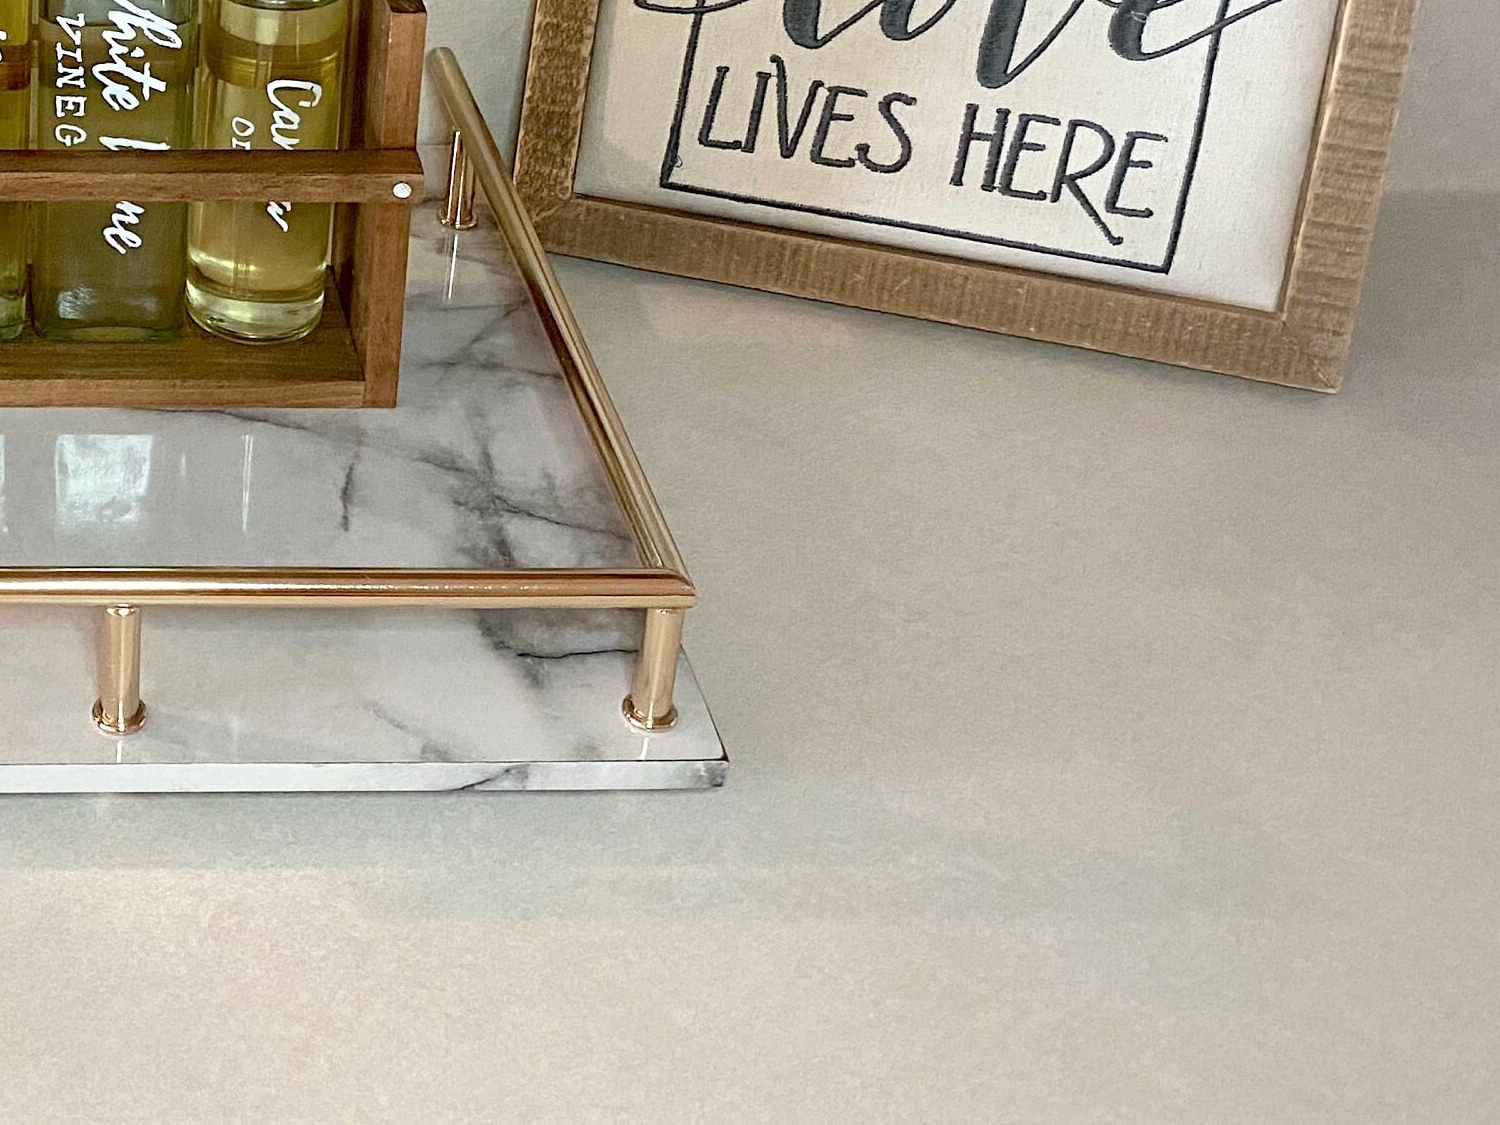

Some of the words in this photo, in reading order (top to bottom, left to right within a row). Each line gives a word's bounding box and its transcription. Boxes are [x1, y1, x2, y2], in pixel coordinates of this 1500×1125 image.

[55, 12, 88, 147] VINEG
[231, 117, 255, 150] OI
[698, 54, 917, 174] LIVES
[949, 102, 1169, 246] HERE
